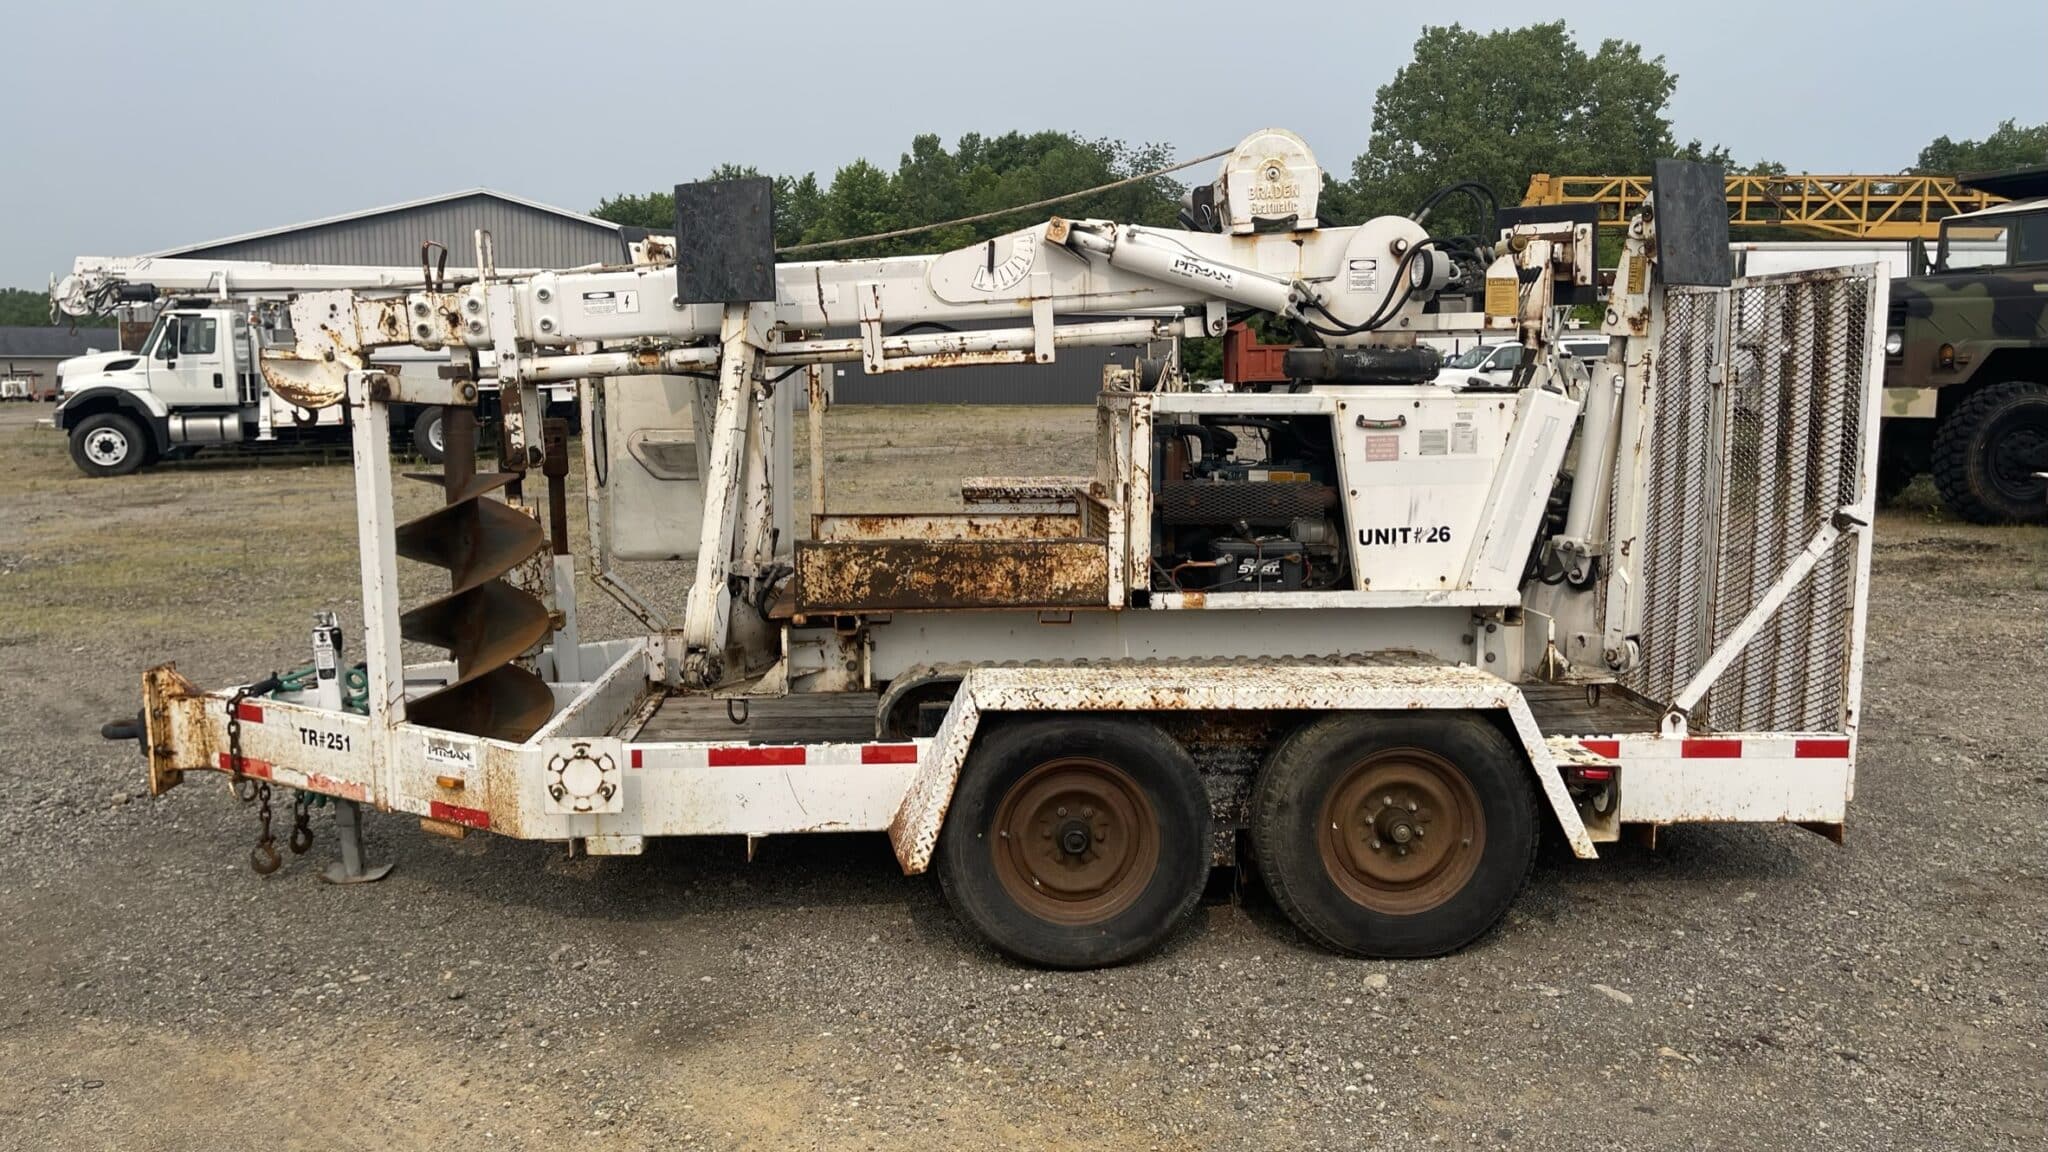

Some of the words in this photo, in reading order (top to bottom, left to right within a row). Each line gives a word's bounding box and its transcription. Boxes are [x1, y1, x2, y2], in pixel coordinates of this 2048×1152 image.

[1248, 184, 1299, 200] BRADEN
[1238, 564, 1281, 574] STRT
[299, 727, 351, 752] TR#251
